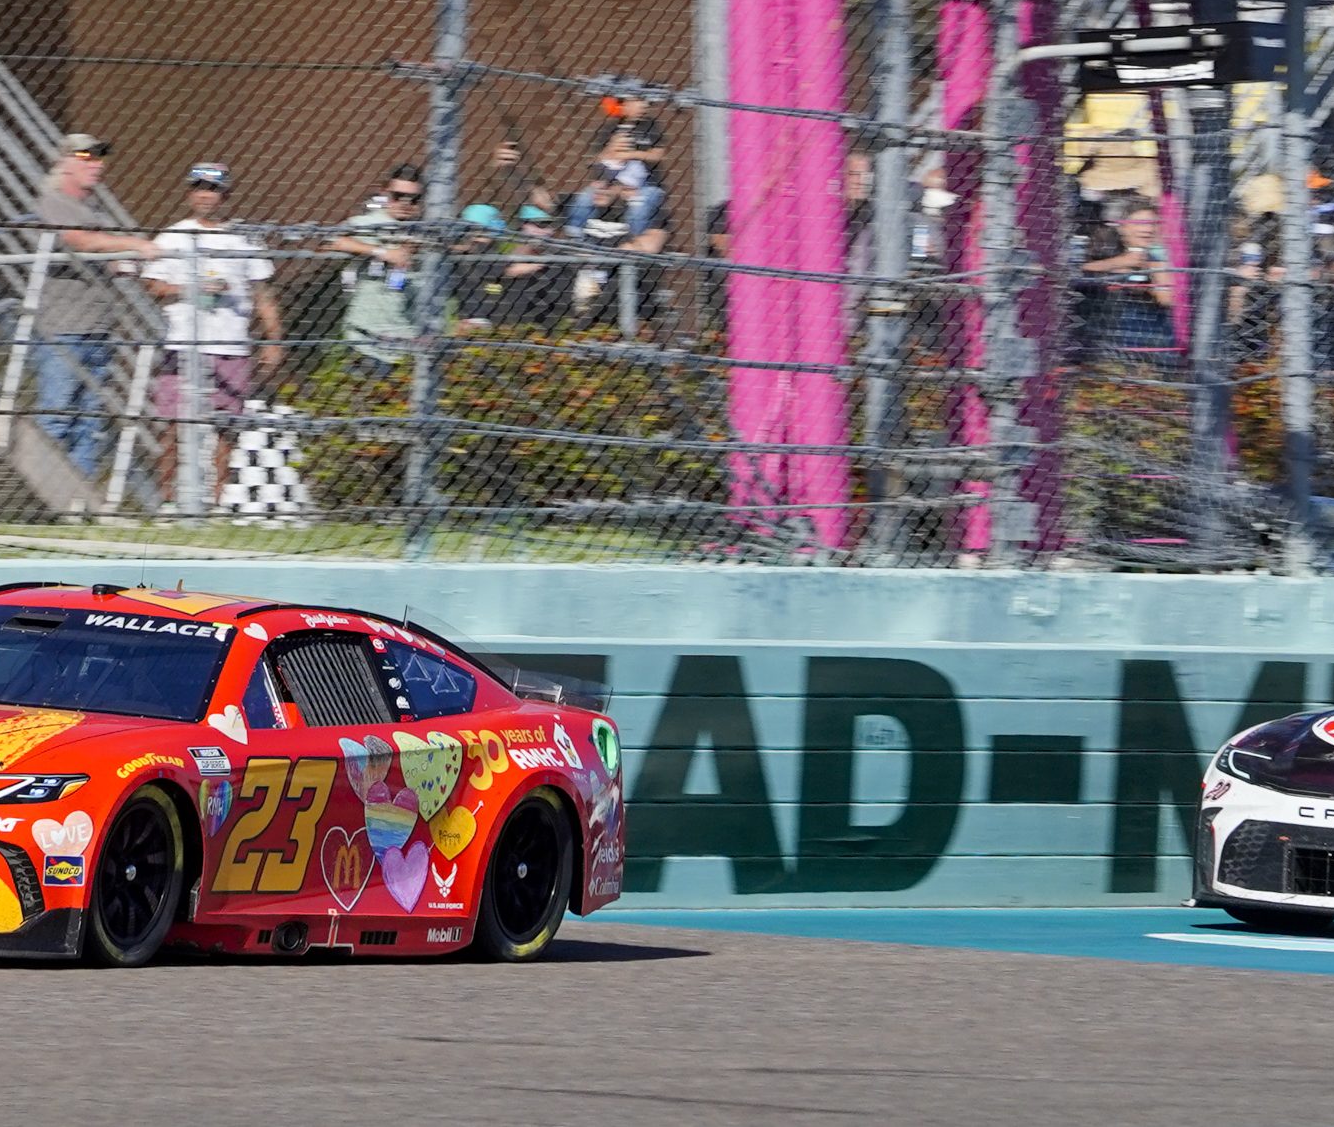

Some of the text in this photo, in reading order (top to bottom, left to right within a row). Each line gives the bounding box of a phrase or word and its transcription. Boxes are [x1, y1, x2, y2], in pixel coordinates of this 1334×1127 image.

[85, 614, 212, 638] WALLACE
[117, 752, 185, 779] GOODYEAR
[458, 725, 548, 791] 50 years of
[508, 748, 565, 770] RMHC
[1205, 781, 1232, 801] 20
[212, 757, 338, 894] 23
[47, 866, 80, 875] SUNOCO
[427, 926, 452, 943] Mobil
